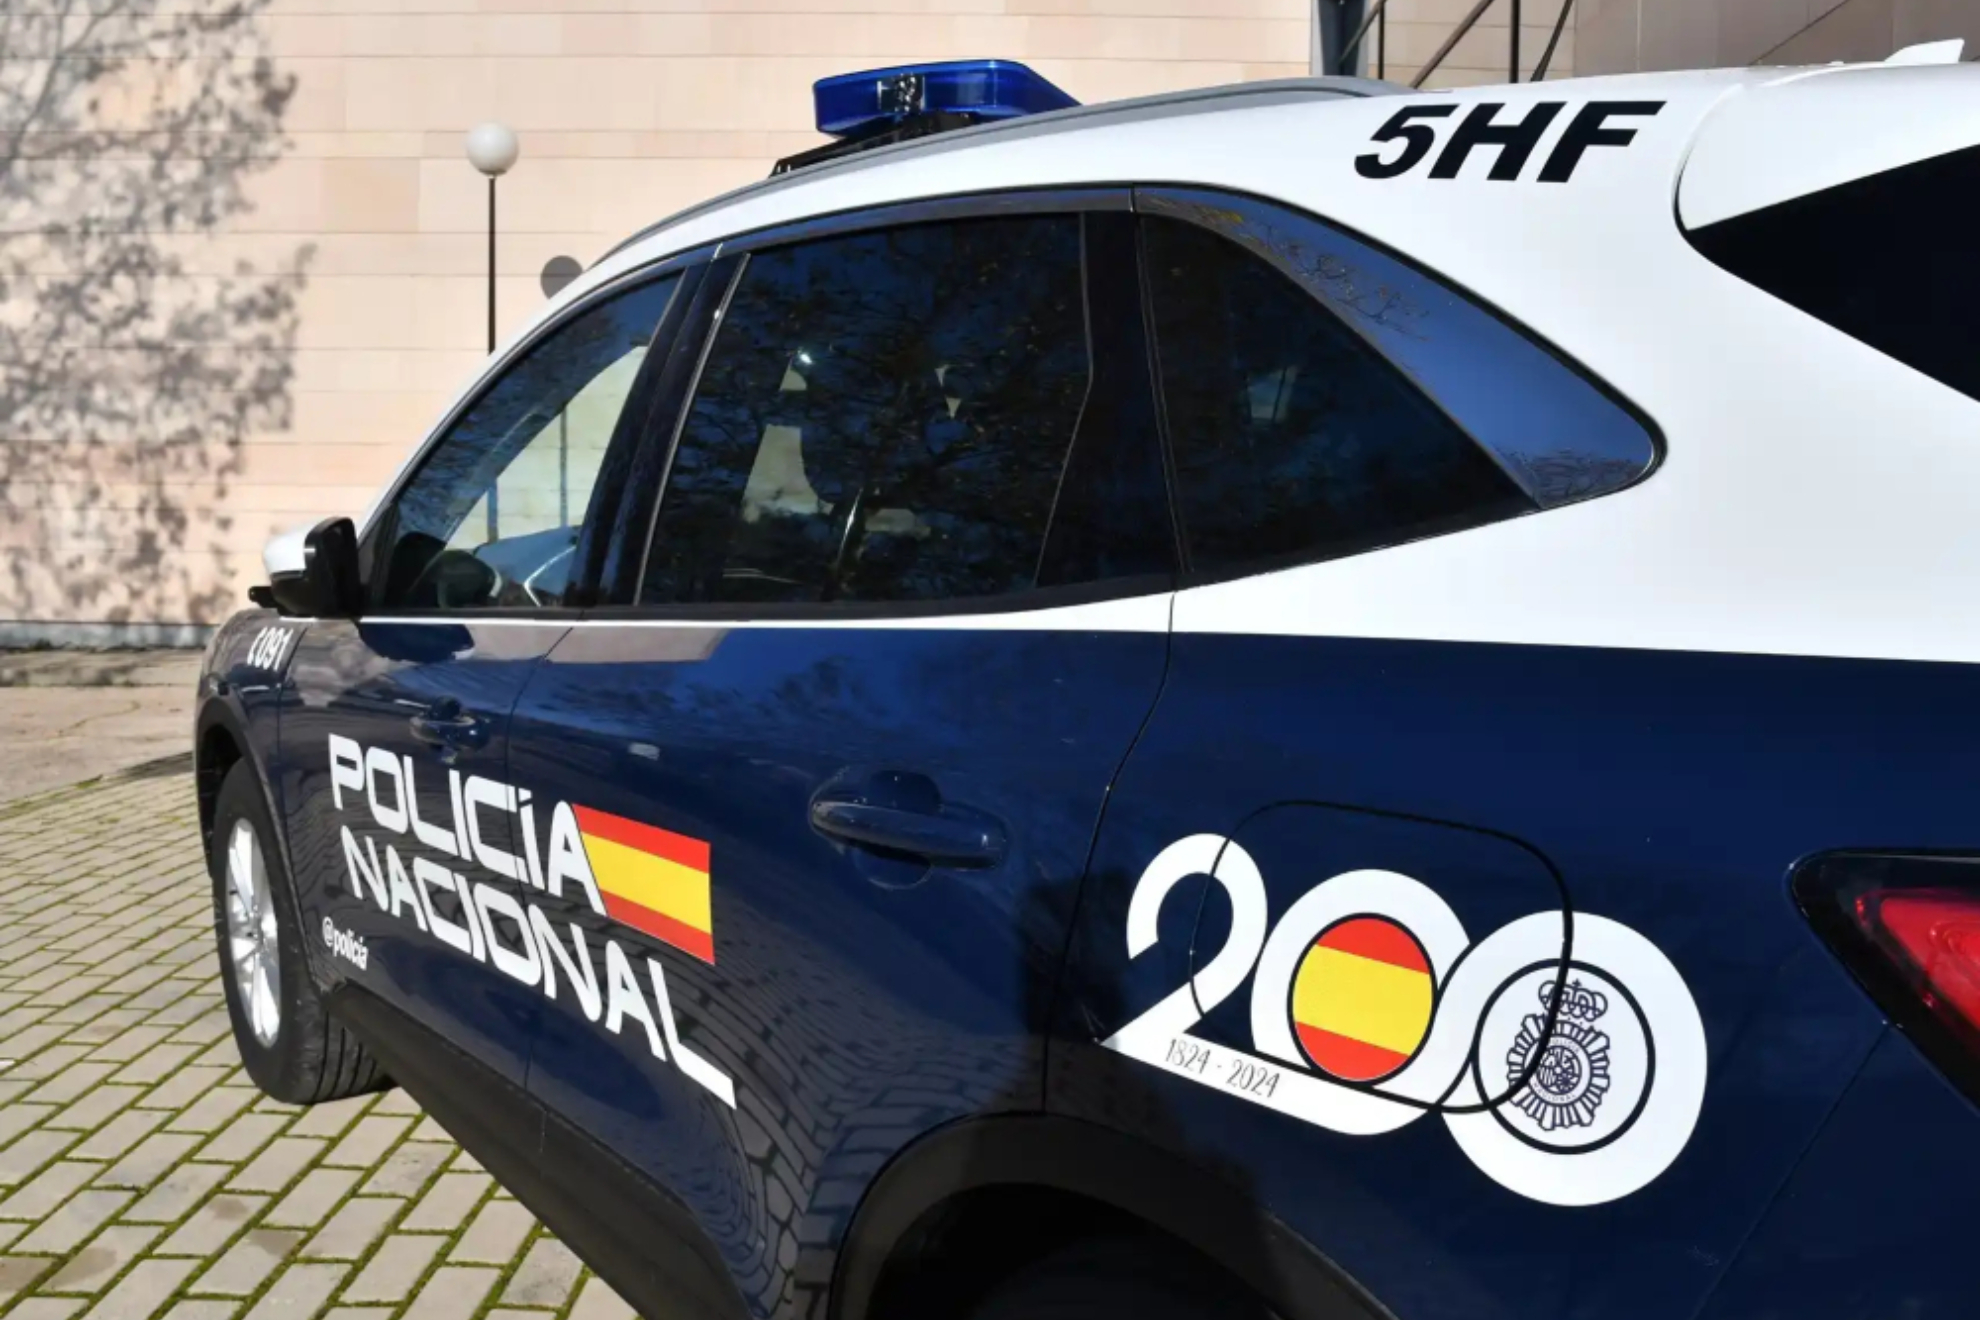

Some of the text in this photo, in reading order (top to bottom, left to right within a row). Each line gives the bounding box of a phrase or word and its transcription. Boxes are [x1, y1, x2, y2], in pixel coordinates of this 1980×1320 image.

[1354, 100, 1668, 183] 5HF
[328, 733, 607, 917] POLICÍA
[341, 825, 737, 1110] NACIONAL
[1102, 833, 1708, 1206] 200
[1165, 1038, 1211, 1074] 1824
[1226, 1059, 1280, 1098] 2024
